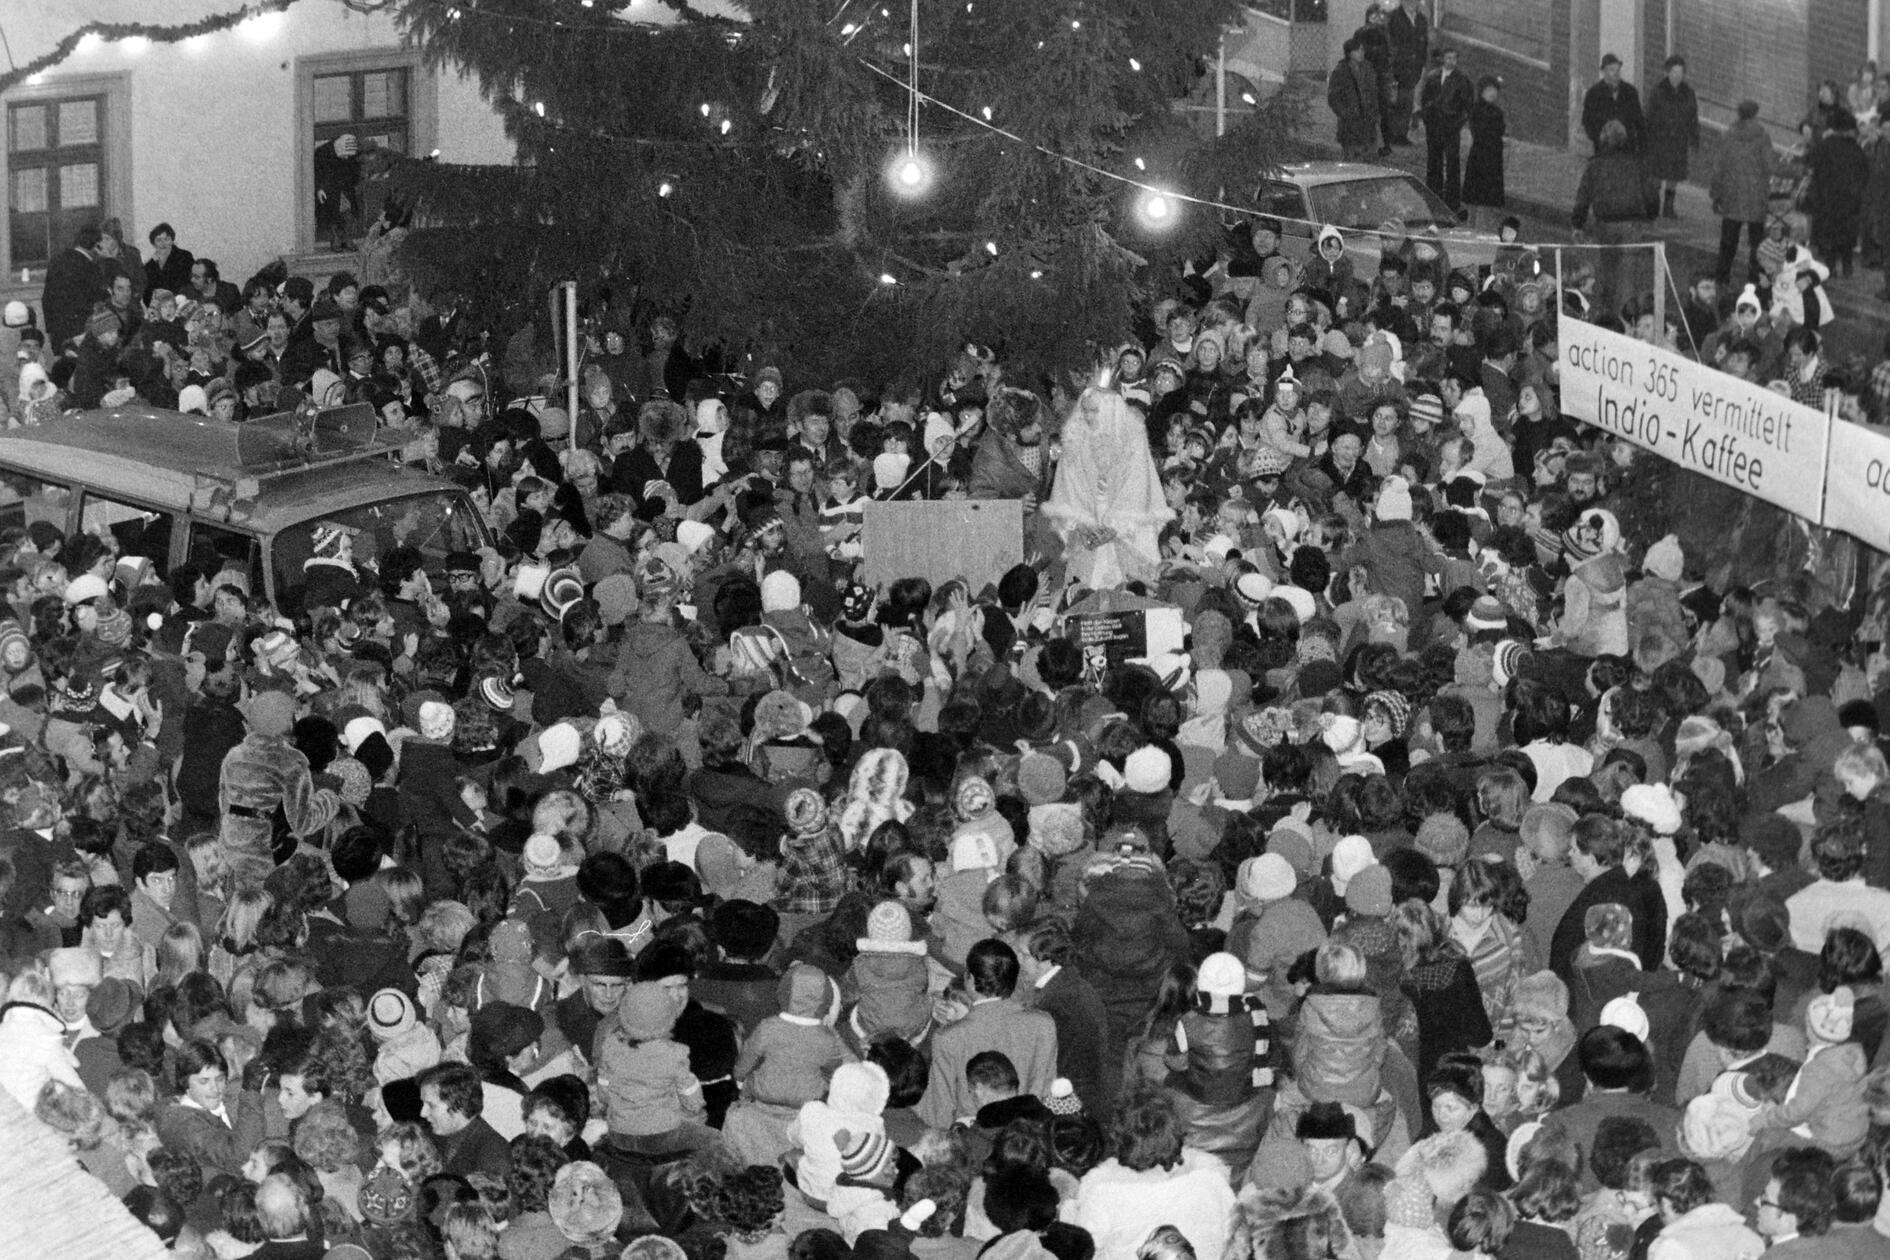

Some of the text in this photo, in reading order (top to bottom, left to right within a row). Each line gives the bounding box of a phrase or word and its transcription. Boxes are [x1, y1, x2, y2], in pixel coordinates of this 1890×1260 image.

[1569, 343, 1792, 453] action 365 vermittelt
